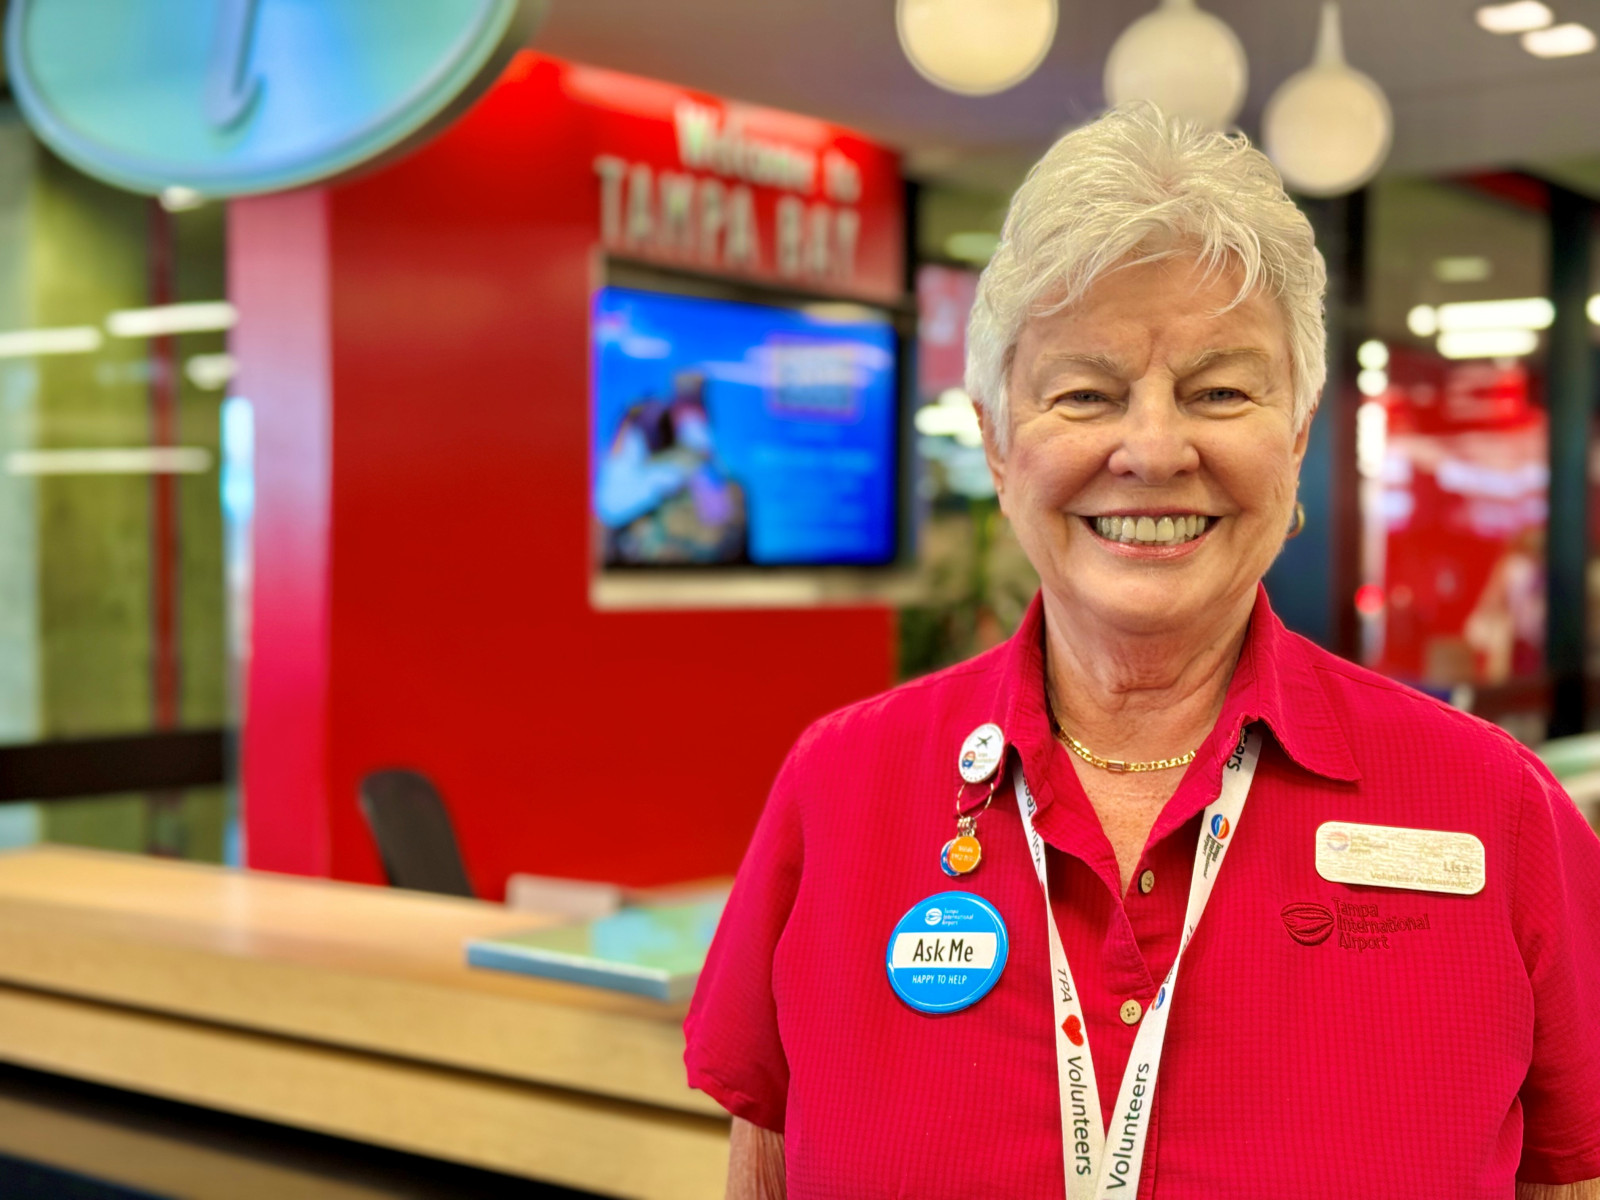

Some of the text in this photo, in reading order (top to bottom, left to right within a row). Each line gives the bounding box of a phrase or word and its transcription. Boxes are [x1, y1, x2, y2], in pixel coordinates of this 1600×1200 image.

[593, 153, 860, 284] TAMPA BAY
[1331, 897, 1379, 920] Tampa
[1336, 913, 1431, 934] International
[912, 938, 974, 962] Ask Me
[1338, 931, 1390, 953] Airport
[912, 974, 967, 985] HAPPY TO HELP
[1057, 968, 1092, 1176] TPA Volunteers
[1106, 1062, 1150, 1190] Volunteers
